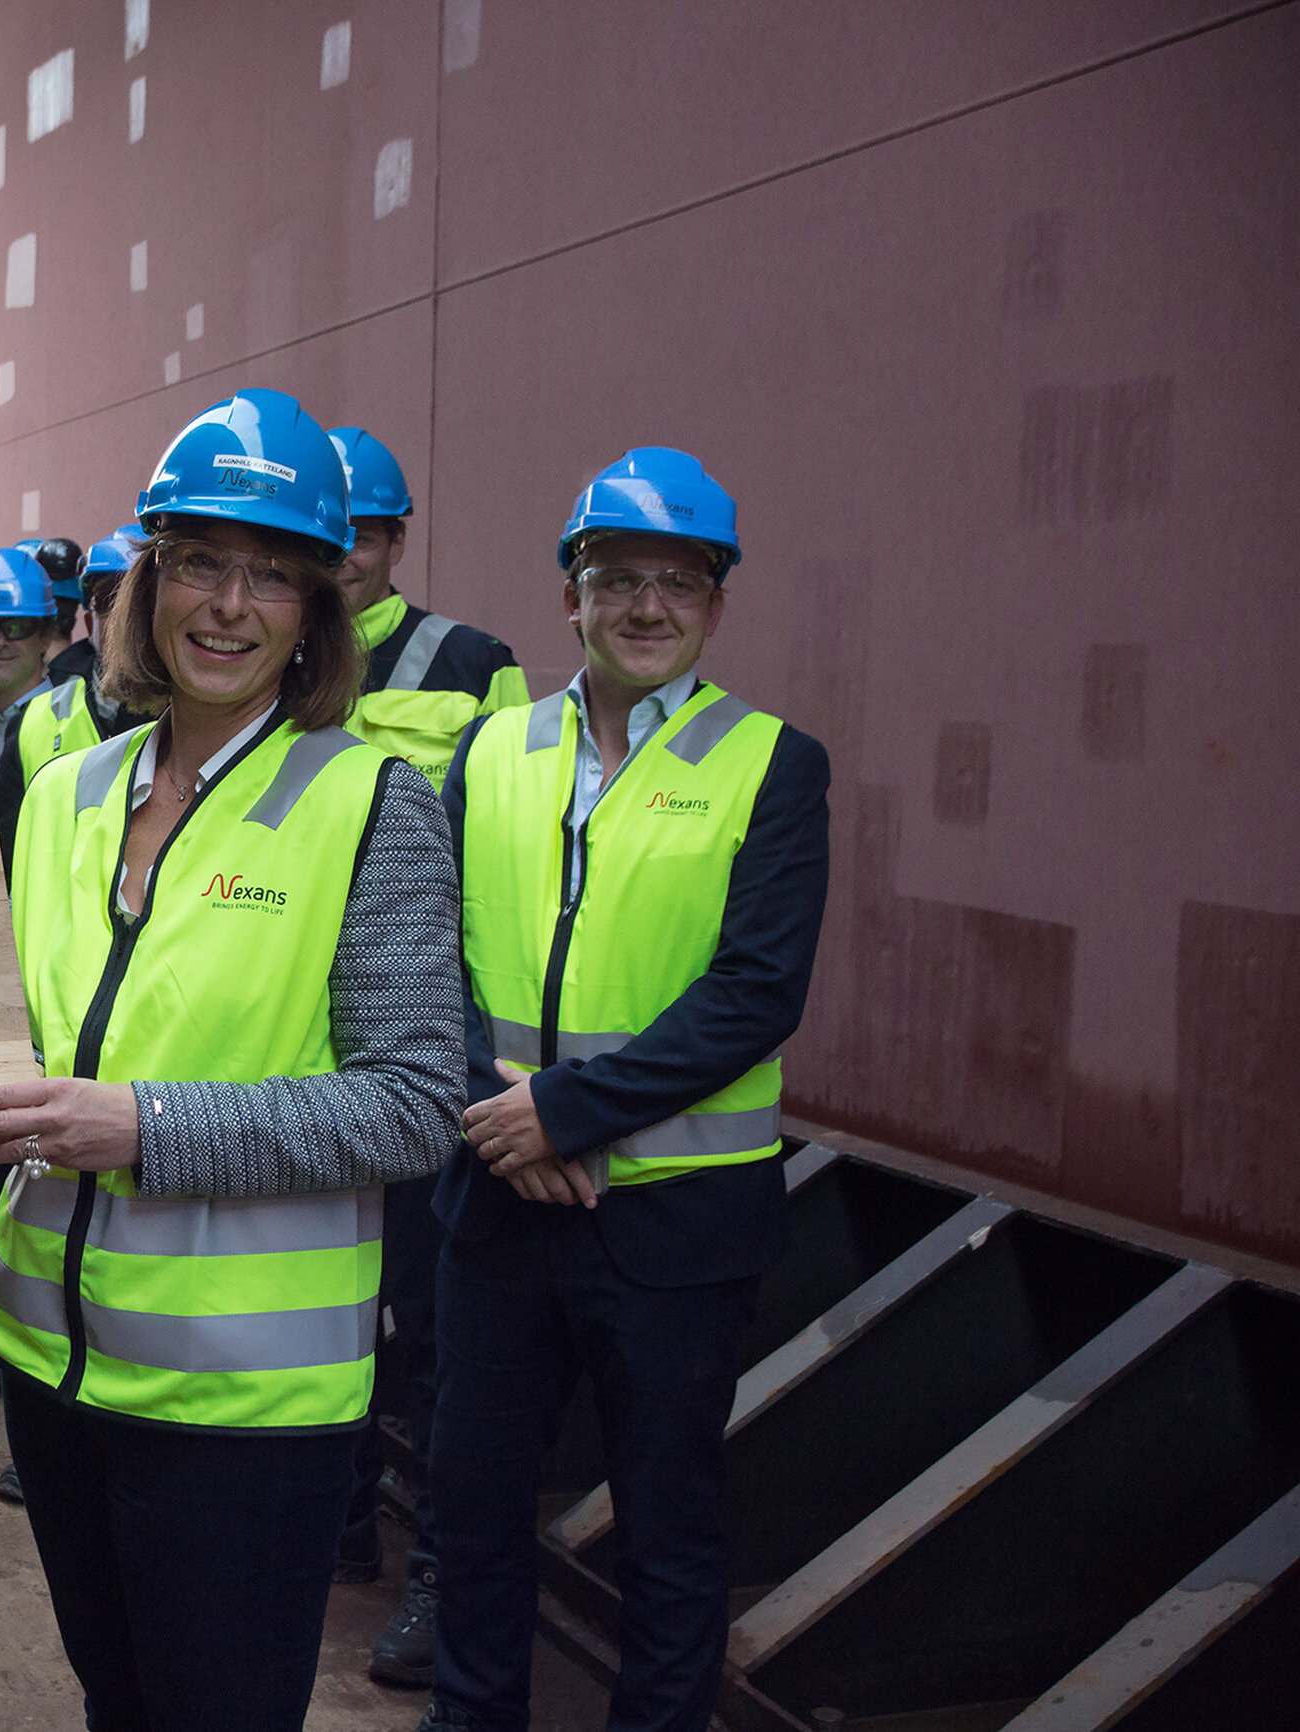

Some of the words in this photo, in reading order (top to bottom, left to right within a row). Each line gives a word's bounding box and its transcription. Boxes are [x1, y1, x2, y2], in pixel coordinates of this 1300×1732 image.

[218, 468, 277, 494] Nexans
[646, 790, 710, 810] Nexans
[201, 873, 287, 906] Nexans
[261, 905, 270, 913] TO
